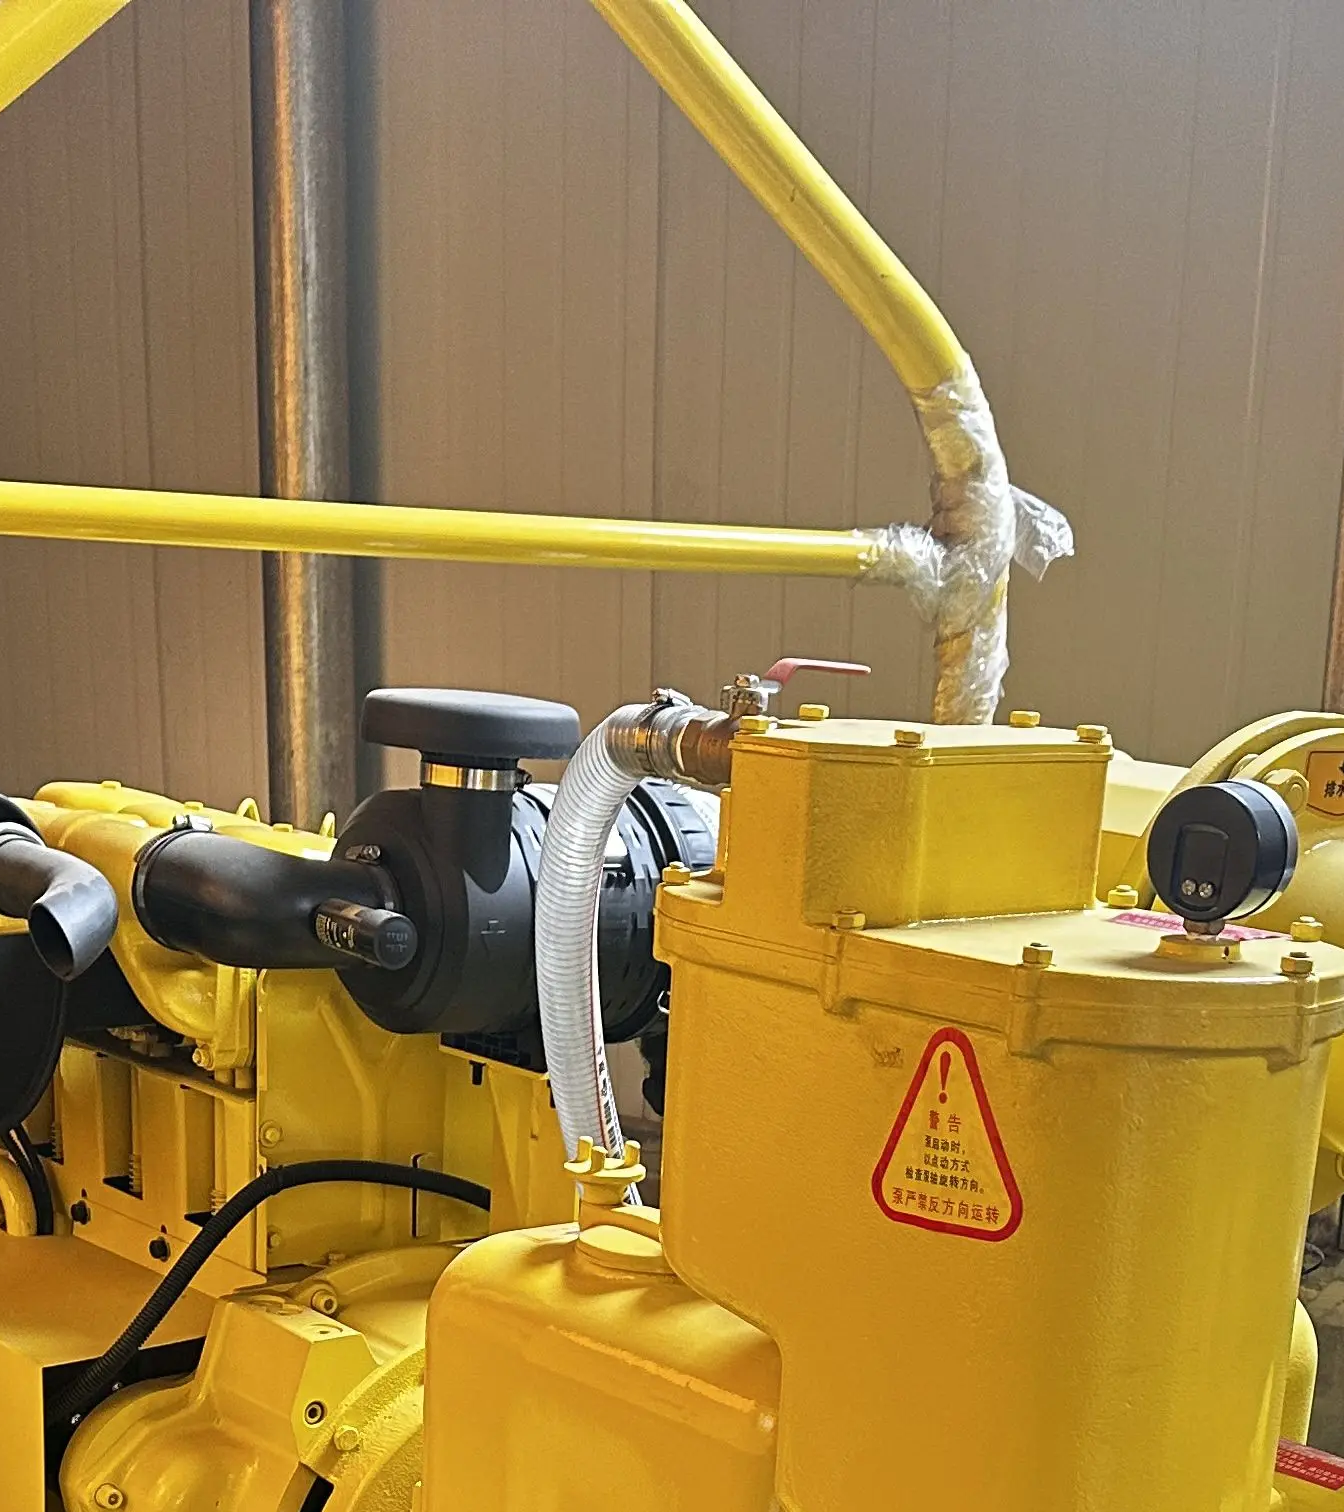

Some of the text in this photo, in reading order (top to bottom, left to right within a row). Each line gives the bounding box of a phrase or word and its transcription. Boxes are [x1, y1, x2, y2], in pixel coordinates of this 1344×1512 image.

[928, 1109, 962, 1134] 警告
[892, 1187, 1000, 1225] 泵严禁反方向运转
